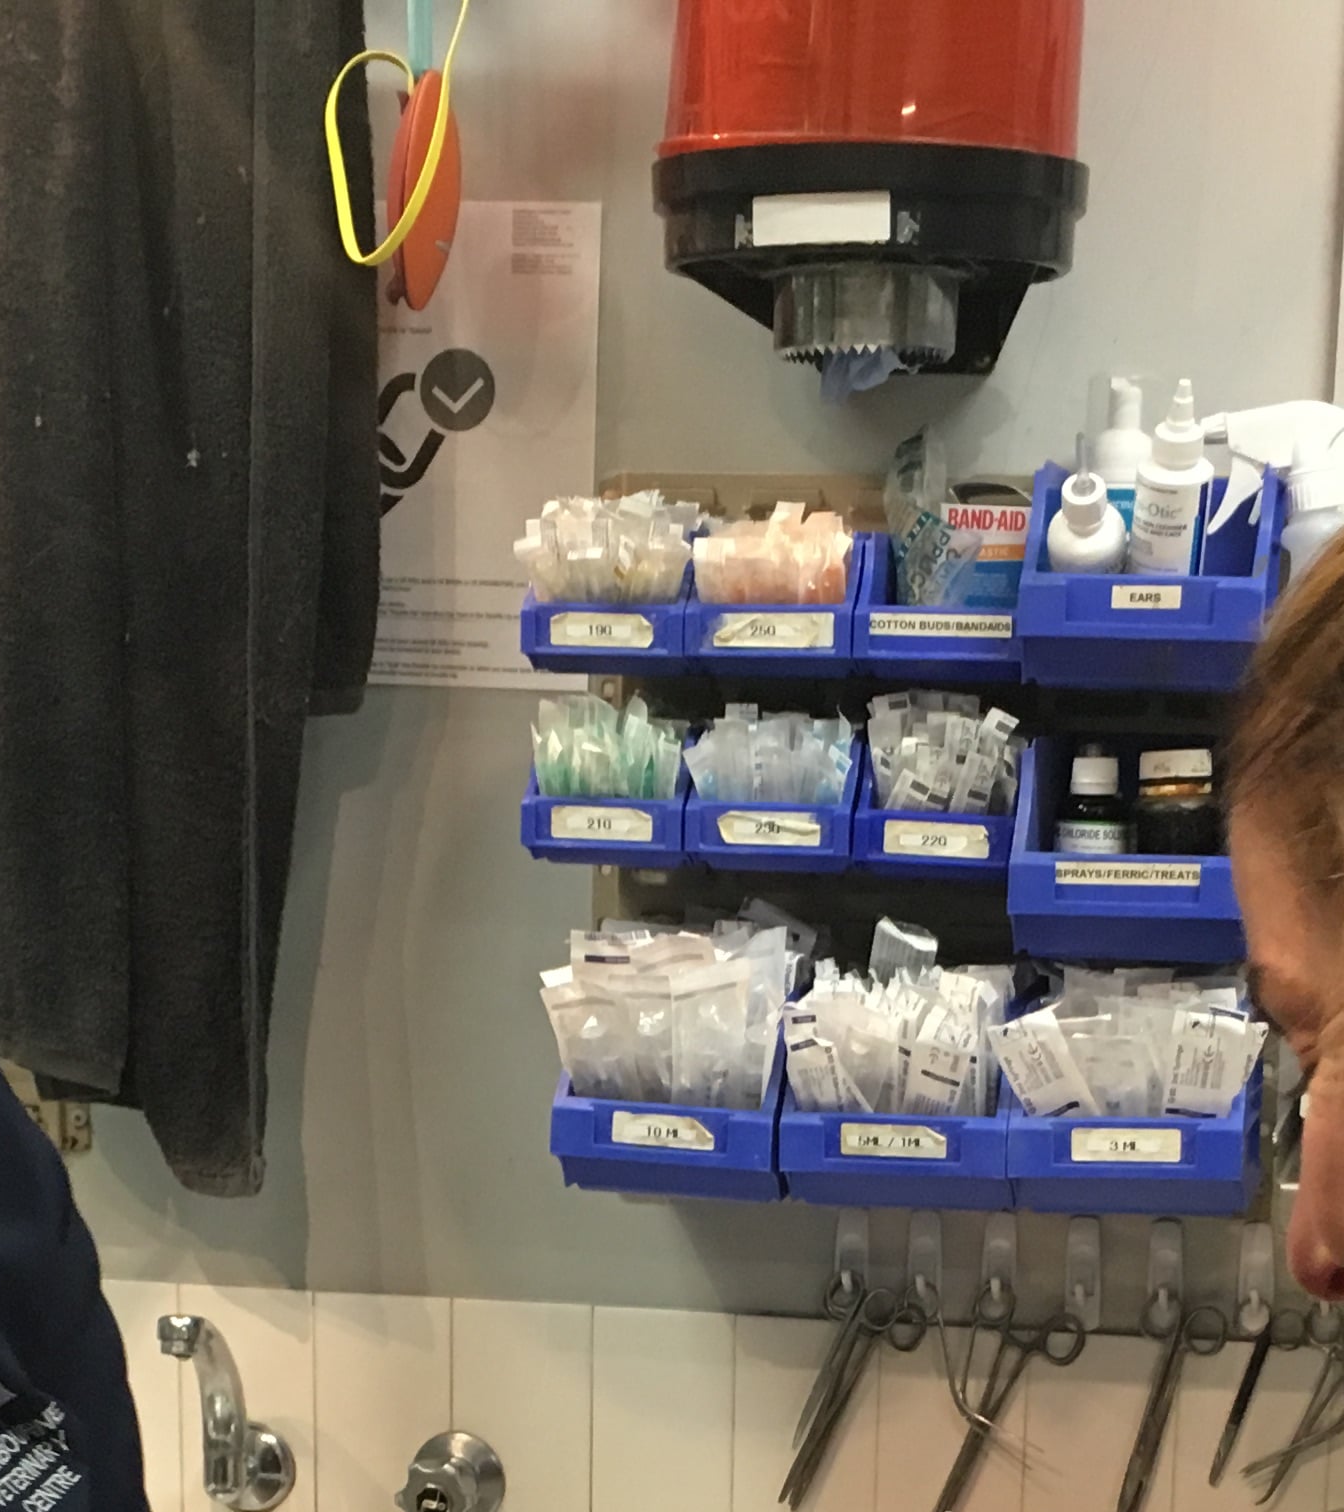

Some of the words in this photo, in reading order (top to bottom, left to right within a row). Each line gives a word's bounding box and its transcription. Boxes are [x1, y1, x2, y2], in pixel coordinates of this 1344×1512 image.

[1129, 592, 1162, 603] EARS
[869, 619, 916, 630] COTTON
[918, 621, 1011, 632] BUDS/BANDAIDS
[1056, 868, 1200, 881] SPRAYS/FERRIC/TREATS
